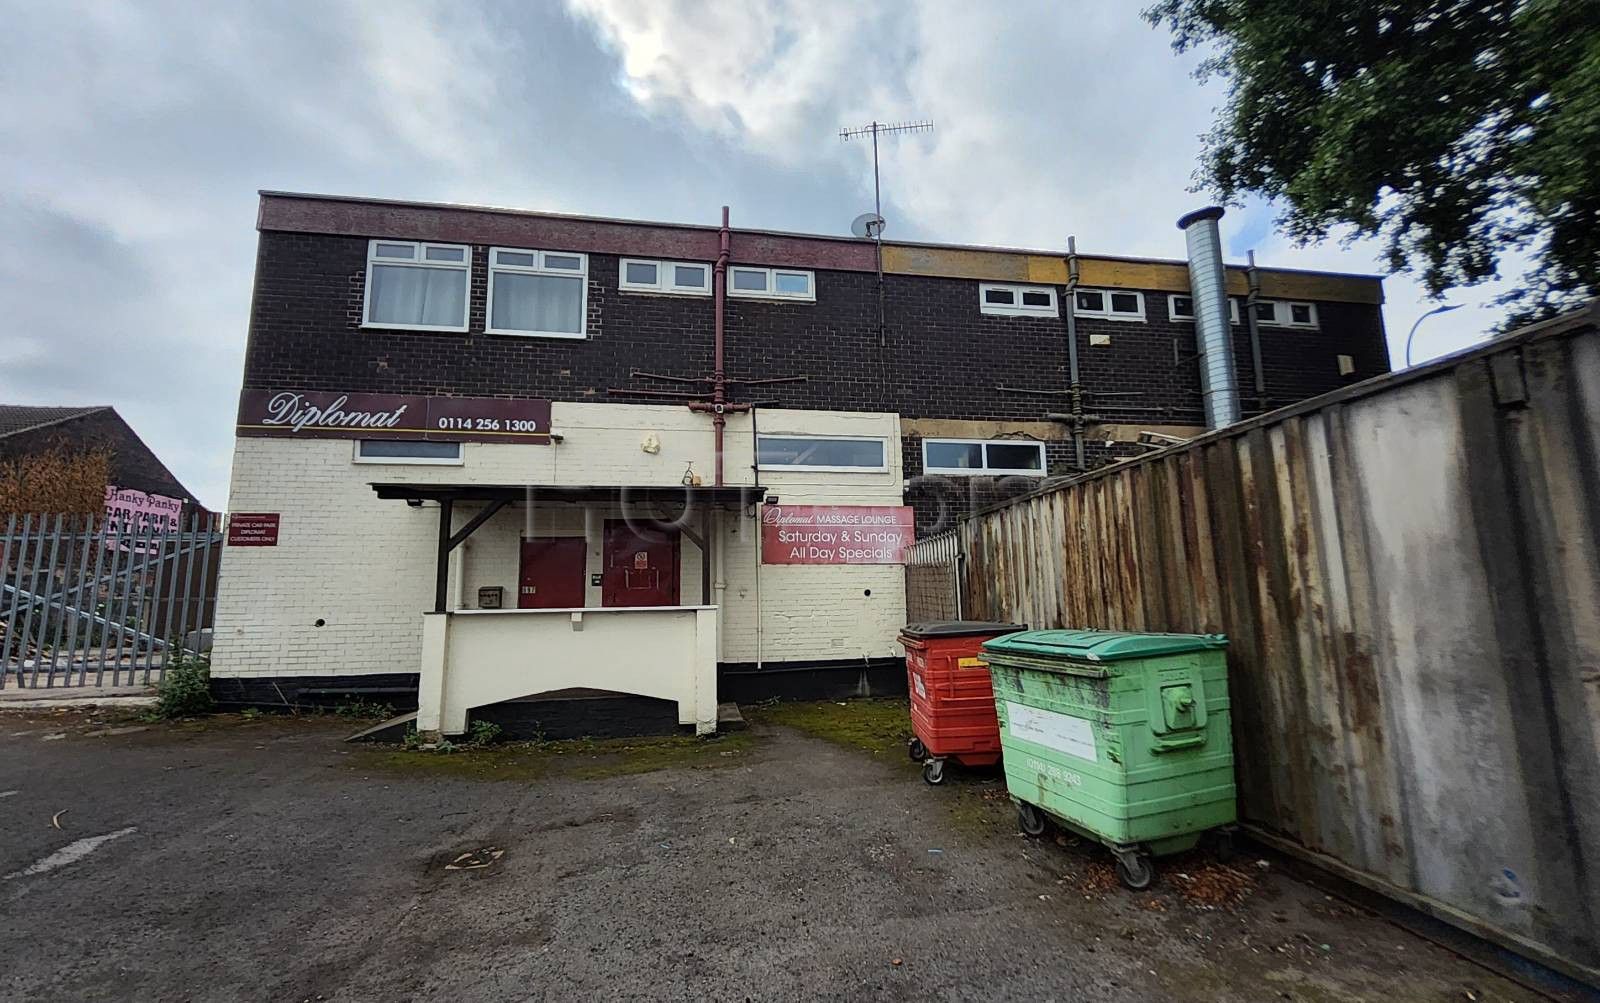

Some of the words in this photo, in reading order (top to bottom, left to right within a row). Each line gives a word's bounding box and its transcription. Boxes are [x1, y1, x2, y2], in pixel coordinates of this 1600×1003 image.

[262, 392, 408, 433] Diplomat
[438, 417, 472, 430] 0114
[475, 418, 500, 431] 256
[505, 419, 536, 432] 1300
[104, 488, 145, 507] Hanky
[146, 495, 180, 513] Panky
[170, 518, 177, 527] &
[763, 507, 813, 528] Diplomat
[816, 515, 861, 524] MASSAGE
[862, 515, 897, 524] LOUNGE
[778, 530, 838, 545] Saturday
[841, 531, 850, 542] &
[854, 530, 903, 545] Sunday
[789, 547, 806, 559] All
[810, 547, 836, 561] Day
[838, 546, 893, 561] Specials
